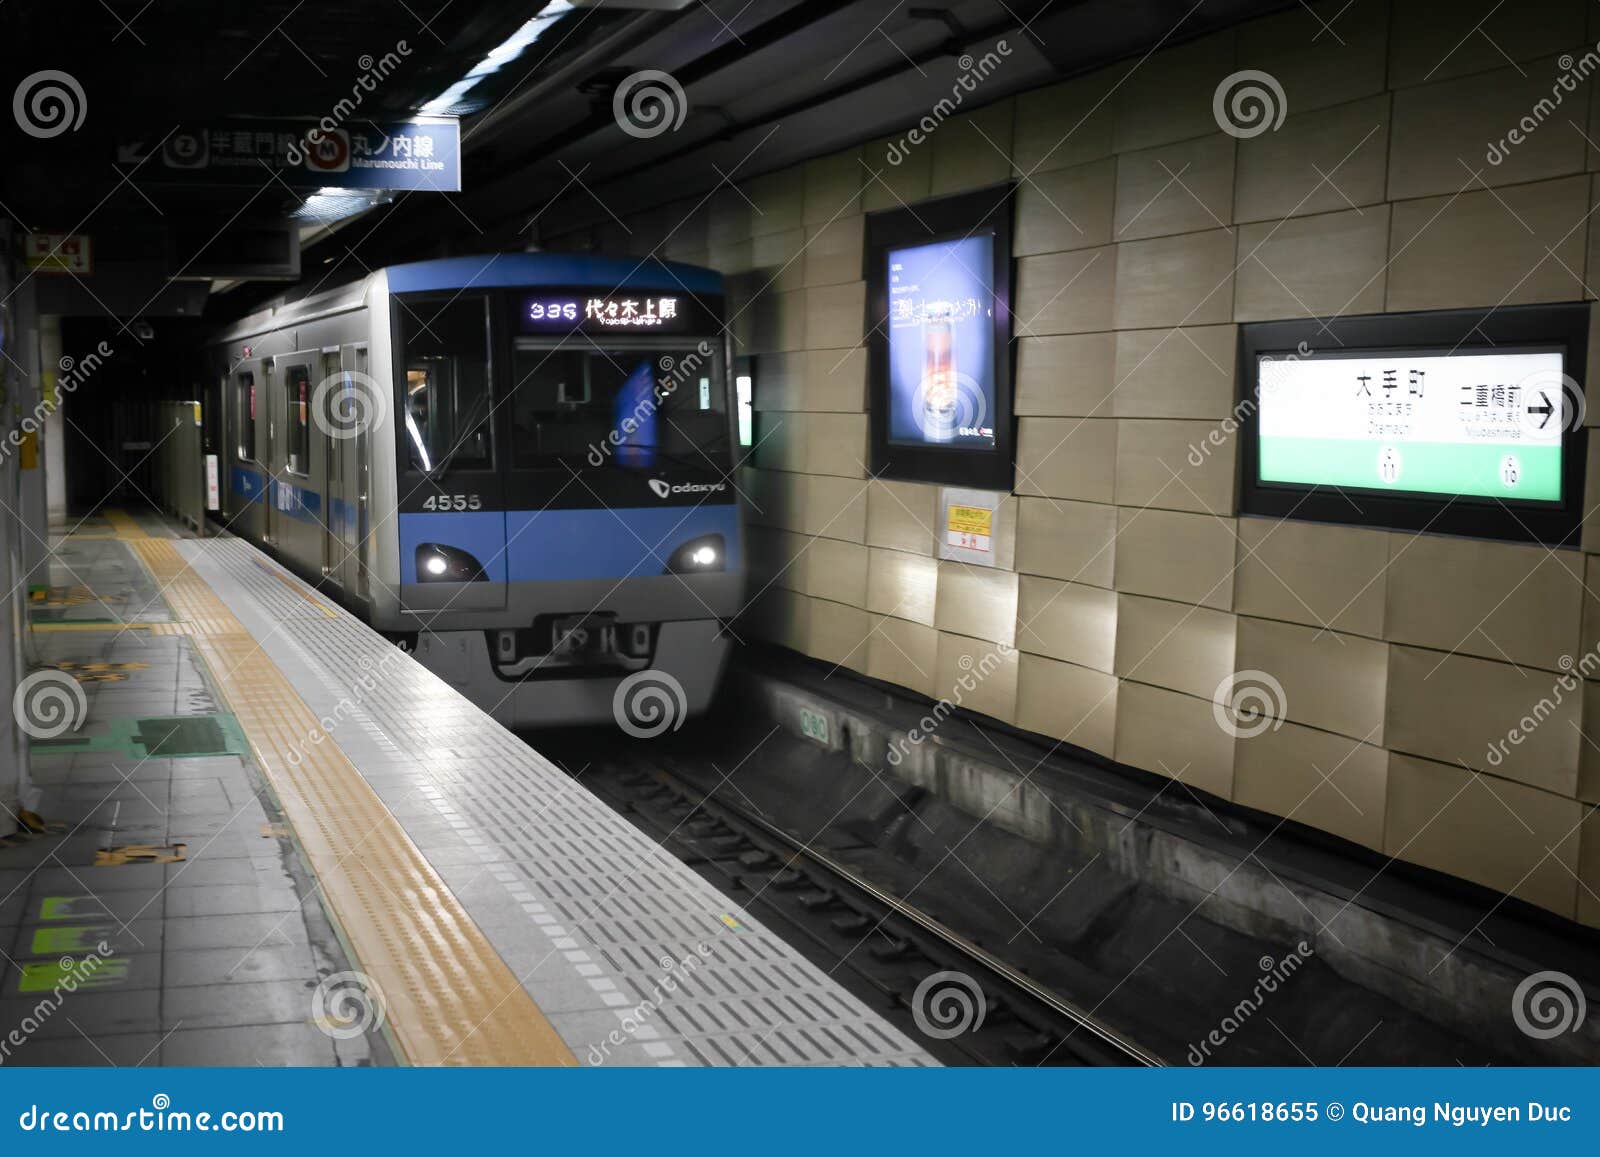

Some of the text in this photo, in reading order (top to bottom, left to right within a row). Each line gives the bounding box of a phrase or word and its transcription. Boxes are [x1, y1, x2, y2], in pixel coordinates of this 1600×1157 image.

[352, 134, 434, 158] 丸ノ内線
[352, 157, 445, 170] Marunouchi Line
[585, 298, 677, 319] 代々木上原
[422, 495, 482, 511] 4555
